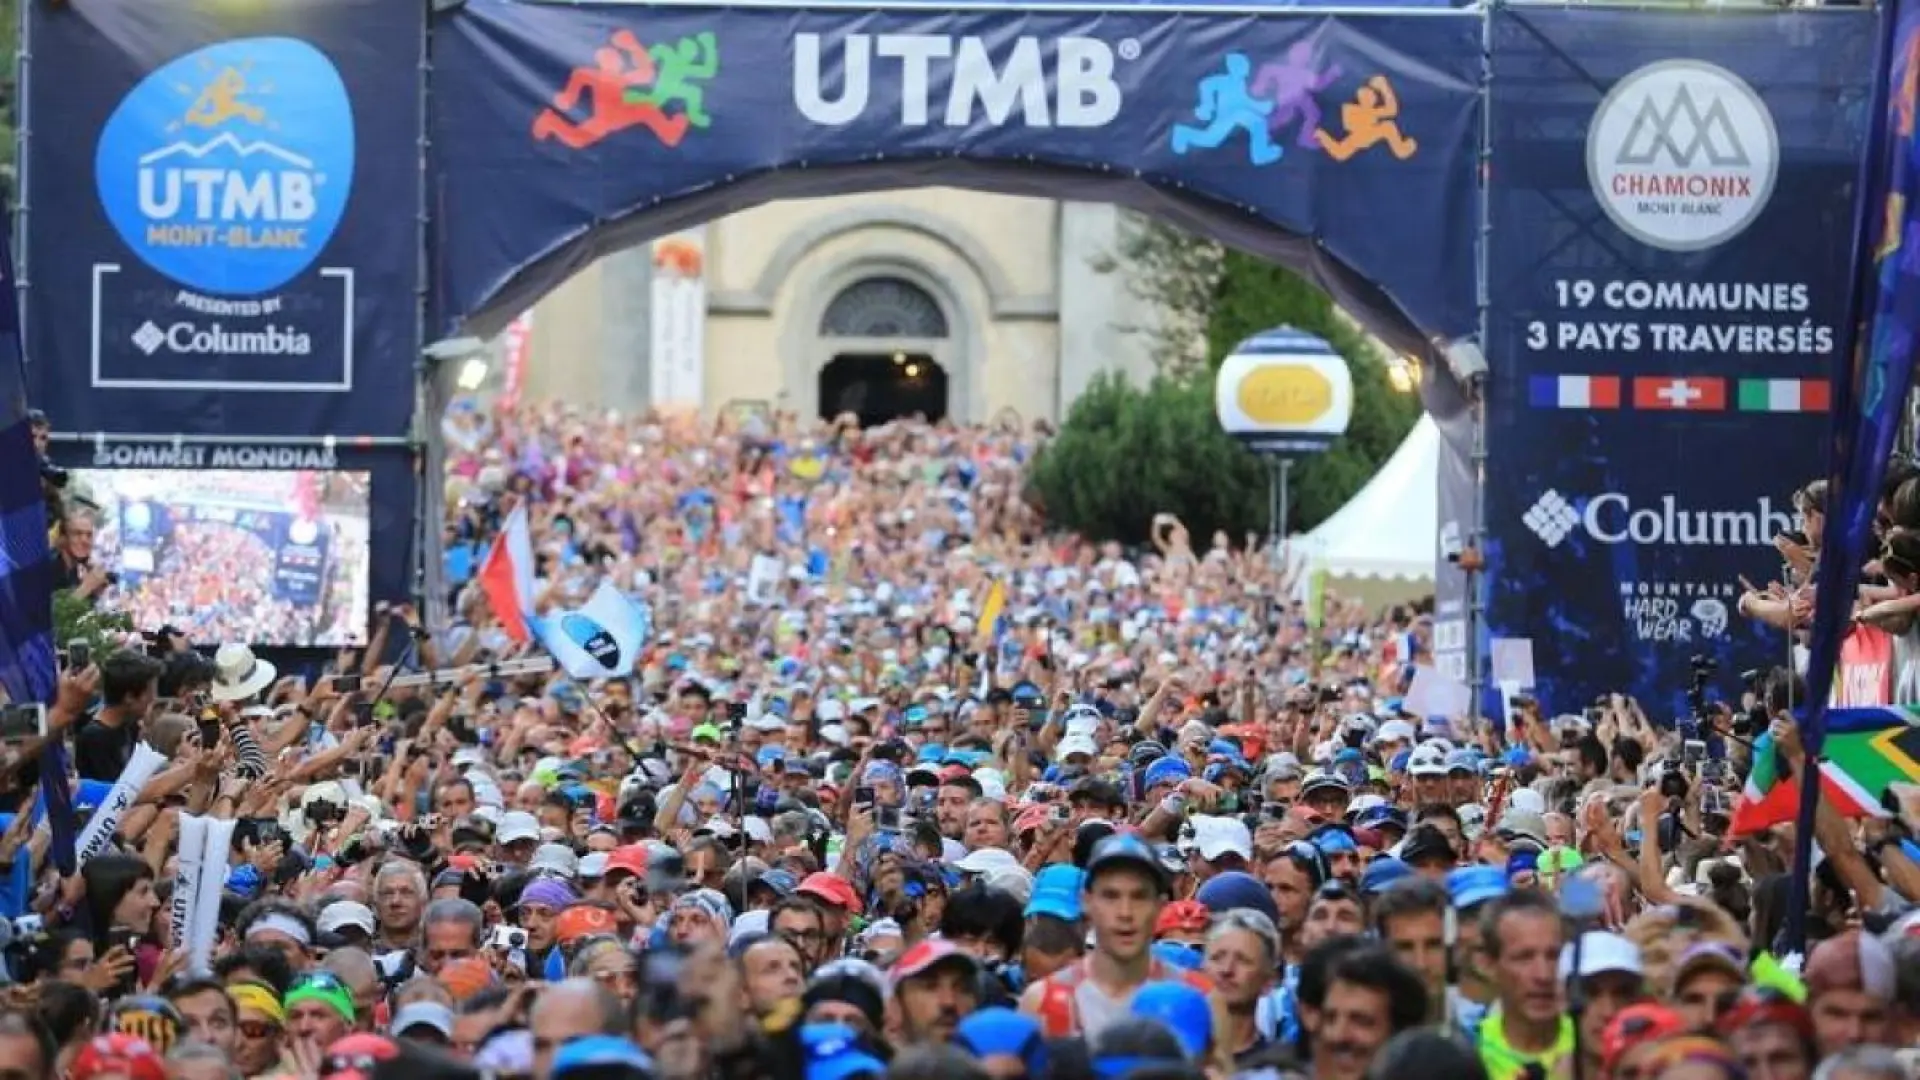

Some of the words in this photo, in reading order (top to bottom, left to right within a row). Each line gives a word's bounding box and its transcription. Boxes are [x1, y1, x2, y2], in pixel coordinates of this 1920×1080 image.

[138, 167, 317, 221] UTMB
[1612, 173, 1751, 197] CHAMONIX
[147, 224, 307, 249] MONT-BLANC
[176, 289, 261, 317] PRESENTED
[261, 296, 281, 314] BY
[1555, 280, 1595, 307] 19
[1604, 281, 1810, 311] COMMUNES
[167, 322, 312, 355] Columbia
[1527, 322, 1548, 349] 3
[1558, 322, 1641, 350] PAYS
[1650, 317, 1834, 353] TRAVERSÉS
[1583, 493, 1804, 545] Columb
[1620, 582, 1734, 596] MOUNTAIN
[1624, 597, 1678, 619] HARD
[1636, 616, 1692, 641] WEAR
